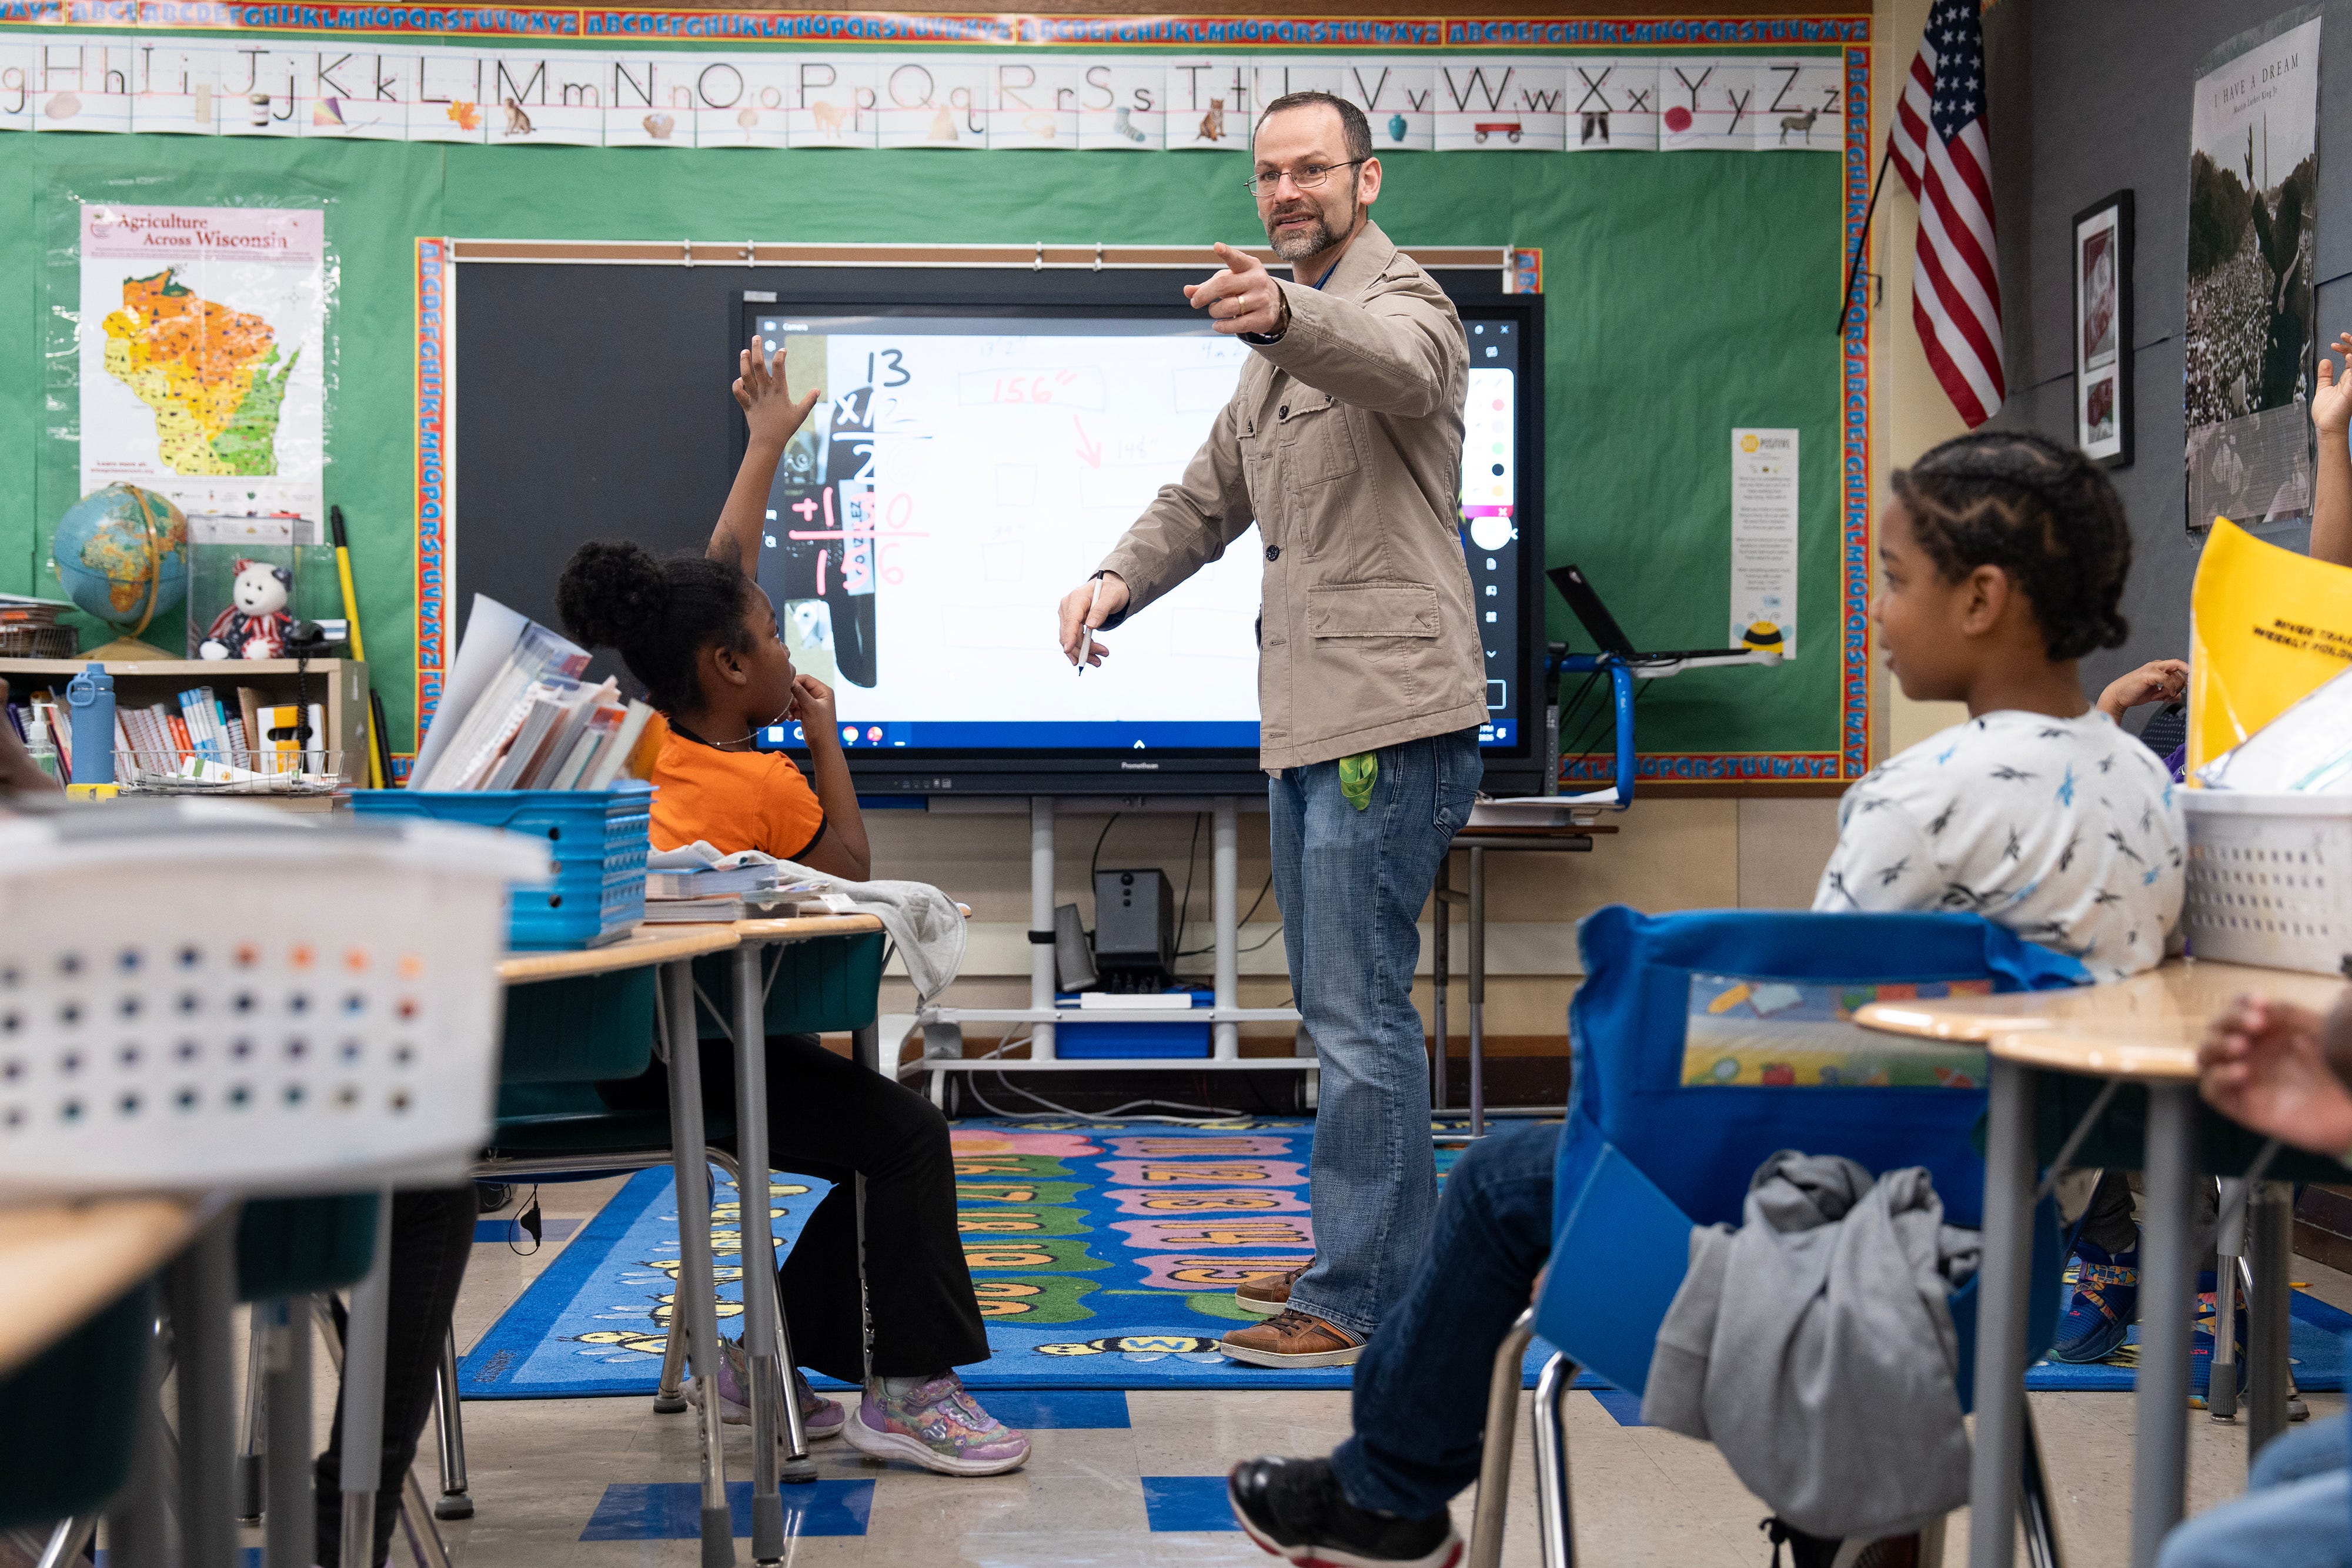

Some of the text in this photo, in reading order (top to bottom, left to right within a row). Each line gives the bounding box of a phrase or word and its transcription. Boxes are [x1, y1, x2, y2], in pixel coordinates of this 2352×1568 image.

[2223, 79, 2245, 103] HAVE
[2251, 75, 2256, 89] A
[2262, 52, 2298, 83] DREAM
[2233, 102, 2247, 113] Martin
[2247, 95, 2260, 107] Luther
[2261, 89, 2271, 100] King
[118, 213, 209, 233] Agriculture
[143, 230, 288, 249] Across Wisconsin
[783, 323, 808, 331] Camera
[867, 348, 911, 388] 13
[816, 541, 904, 596] 156
[2253, 624, 2308, 649] WEEKLY
[1121, 761, 1159, 770] Promethean
